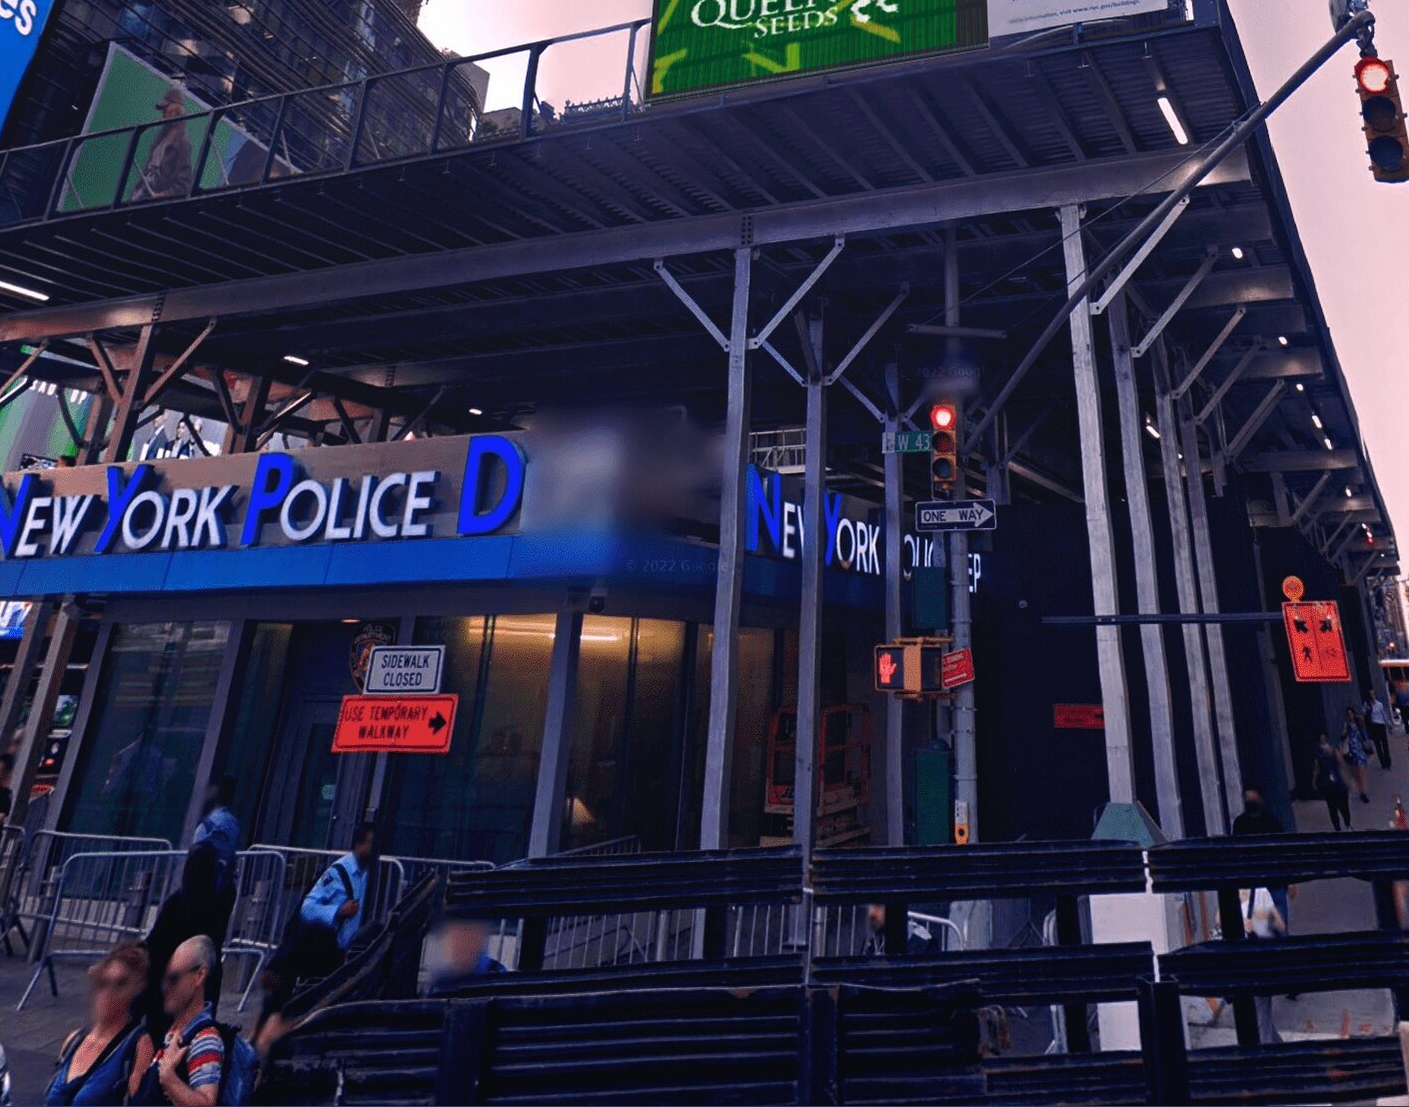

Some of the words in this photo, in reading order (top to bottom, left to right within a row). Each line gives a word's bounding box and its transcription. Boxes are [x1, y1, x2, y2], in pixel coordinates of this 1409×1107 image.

[753, 6, 839, 39] SEEDS
[70, 388, 89, 405] UP
[897, 434, 910, 452] W
[915, 433, 931, 452] 43
[94, 463, 240, 556] YORK
[240, 452, 441, 548] POLICE
[745, 462, 804, 559] NE
[823, 491, 881, 575] YORK
[923, 510, 947, 523] ONE
[959, 508, 985, 522] WAY
[381, 654, 431, 670] SIDEWALK
[383, 671, 423, 687] CLOSED
[343, 704, 366, 723] USE
[370, 704, 429, 722] TEMPORARY
[358, 724, 410, 740] WALKWAY
